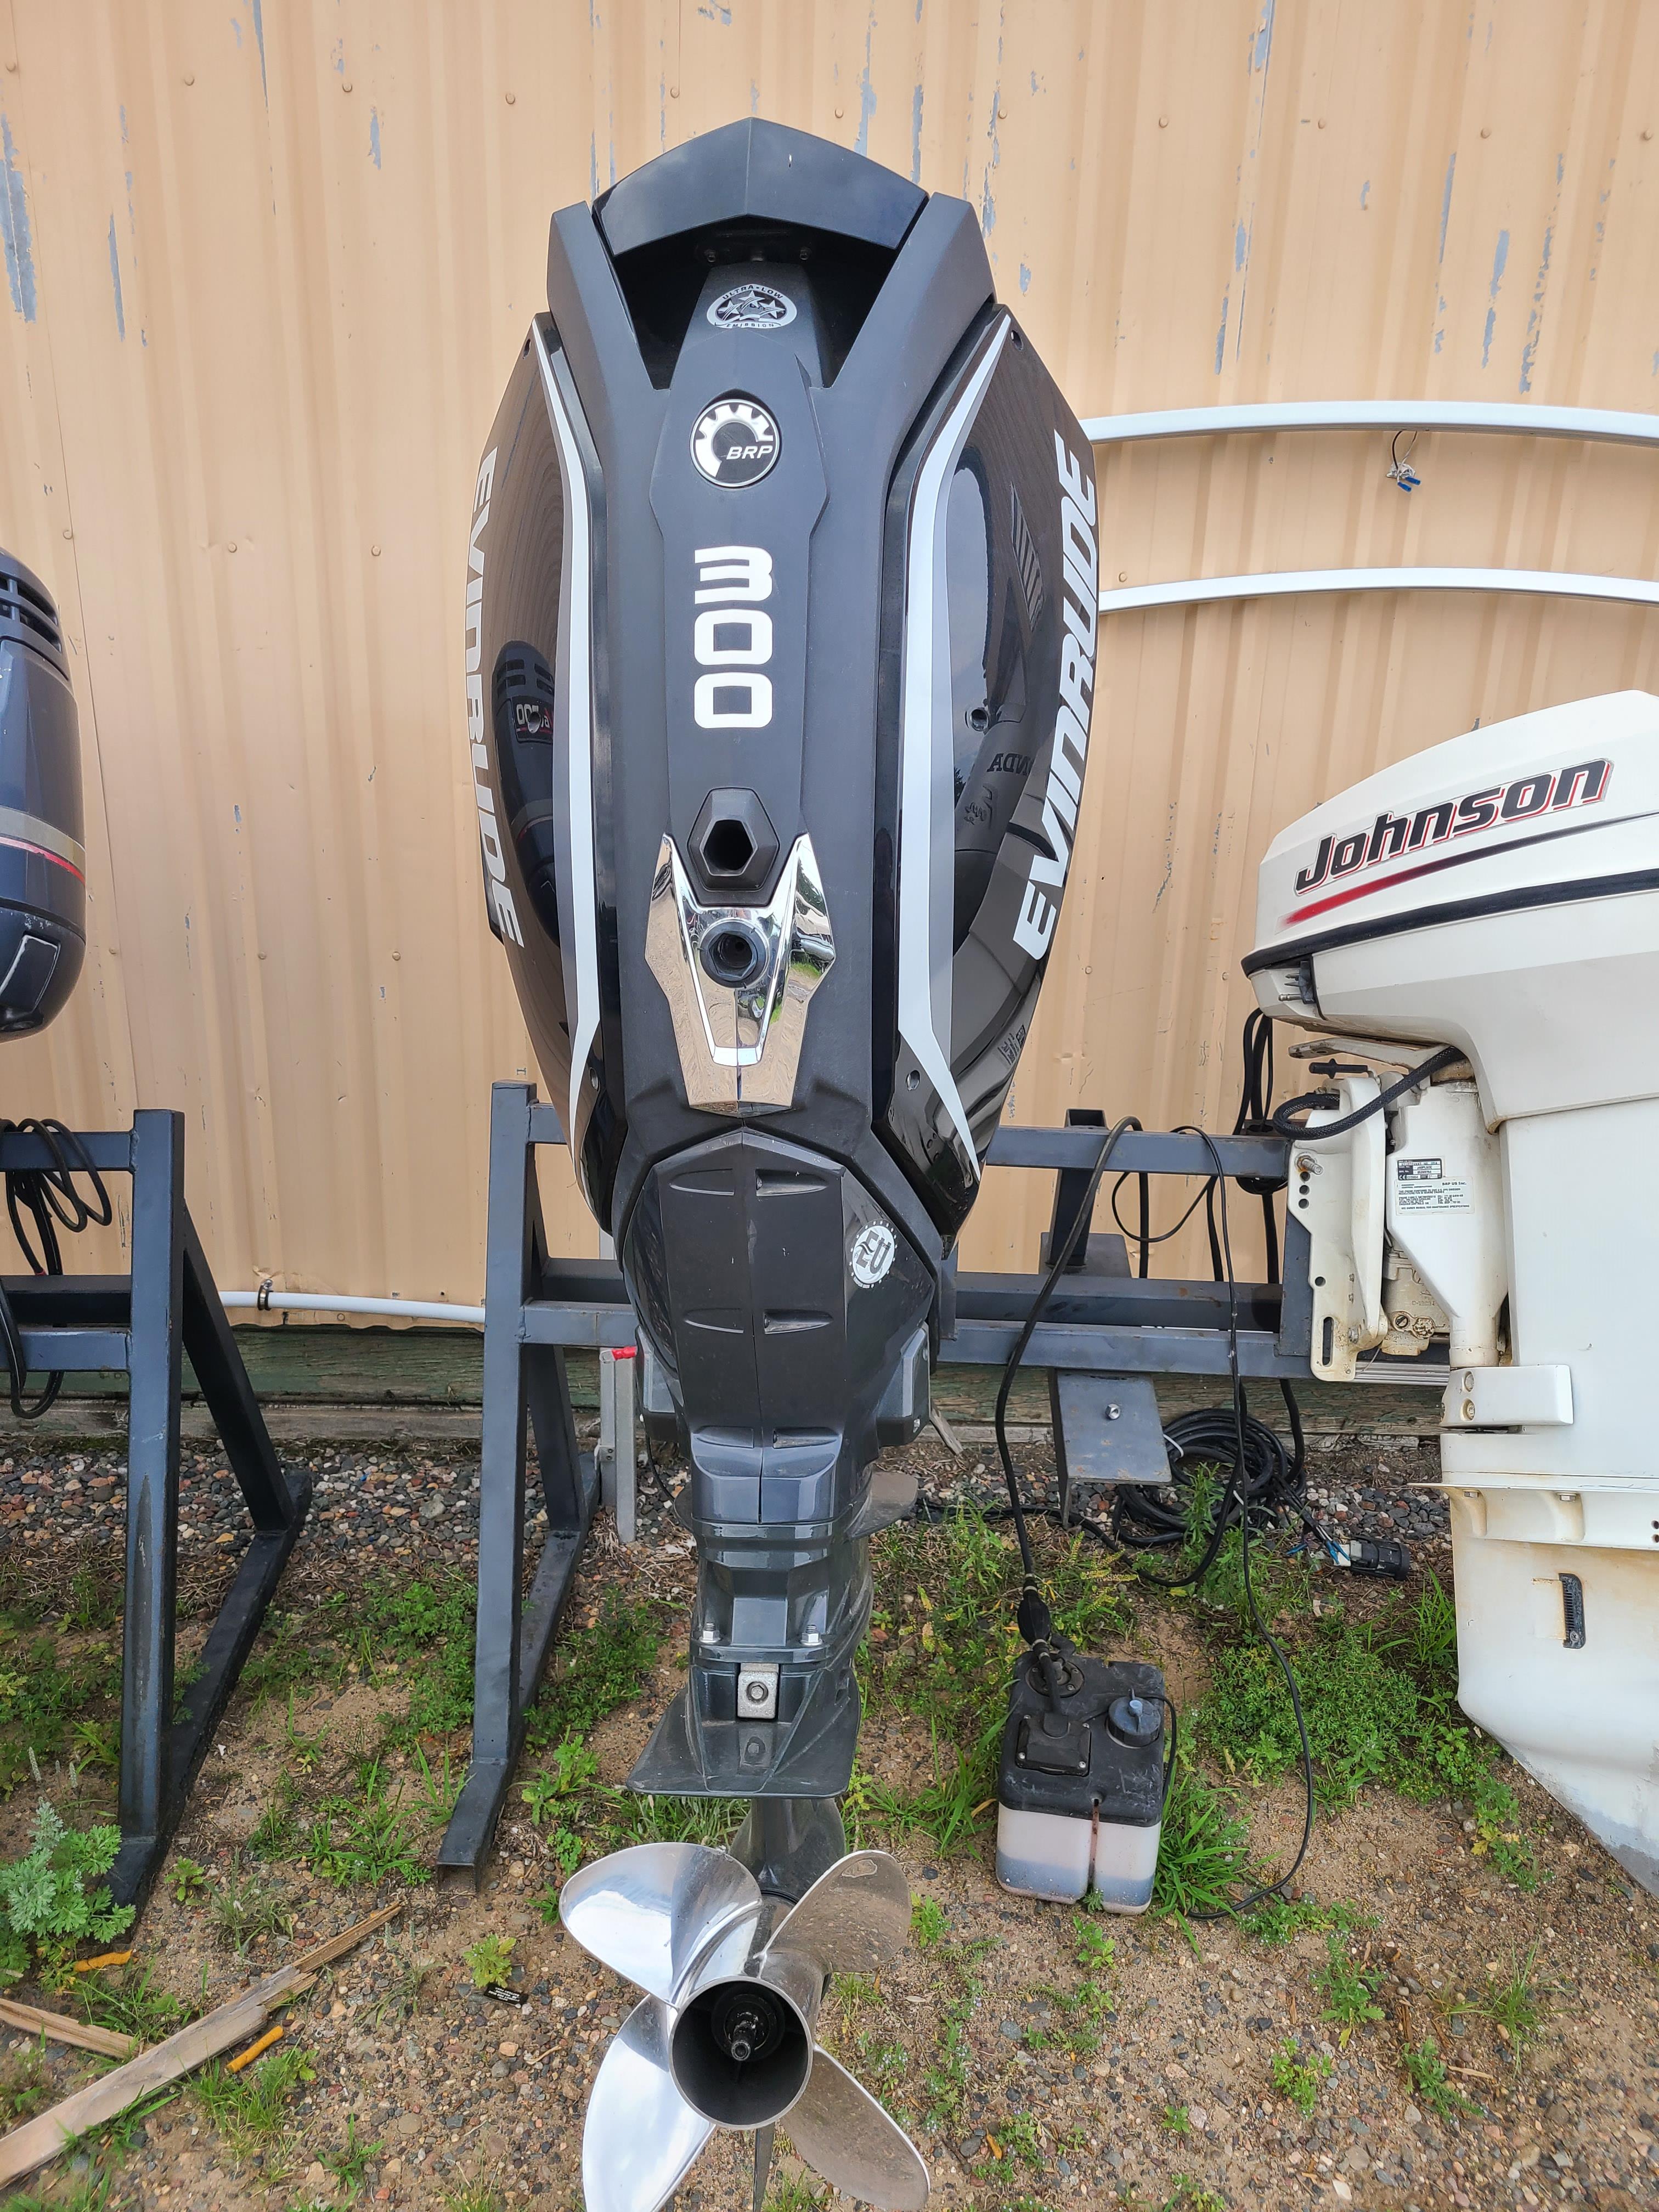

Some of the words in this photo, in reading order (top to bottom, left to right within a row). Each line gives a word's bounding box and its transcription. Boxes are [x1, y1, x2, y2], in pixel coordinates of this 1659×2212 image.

[722, 285, 783, 300] ULTRA-LOW
[726, 445, 774, 460] BRP
[465, 446, 524, 948] EVINRUDE
[694, 545, 773, 729] 300
[1013, 428, 1097, 961] EVINRUDE
[1295, 758, 1611, 895] Johnson
